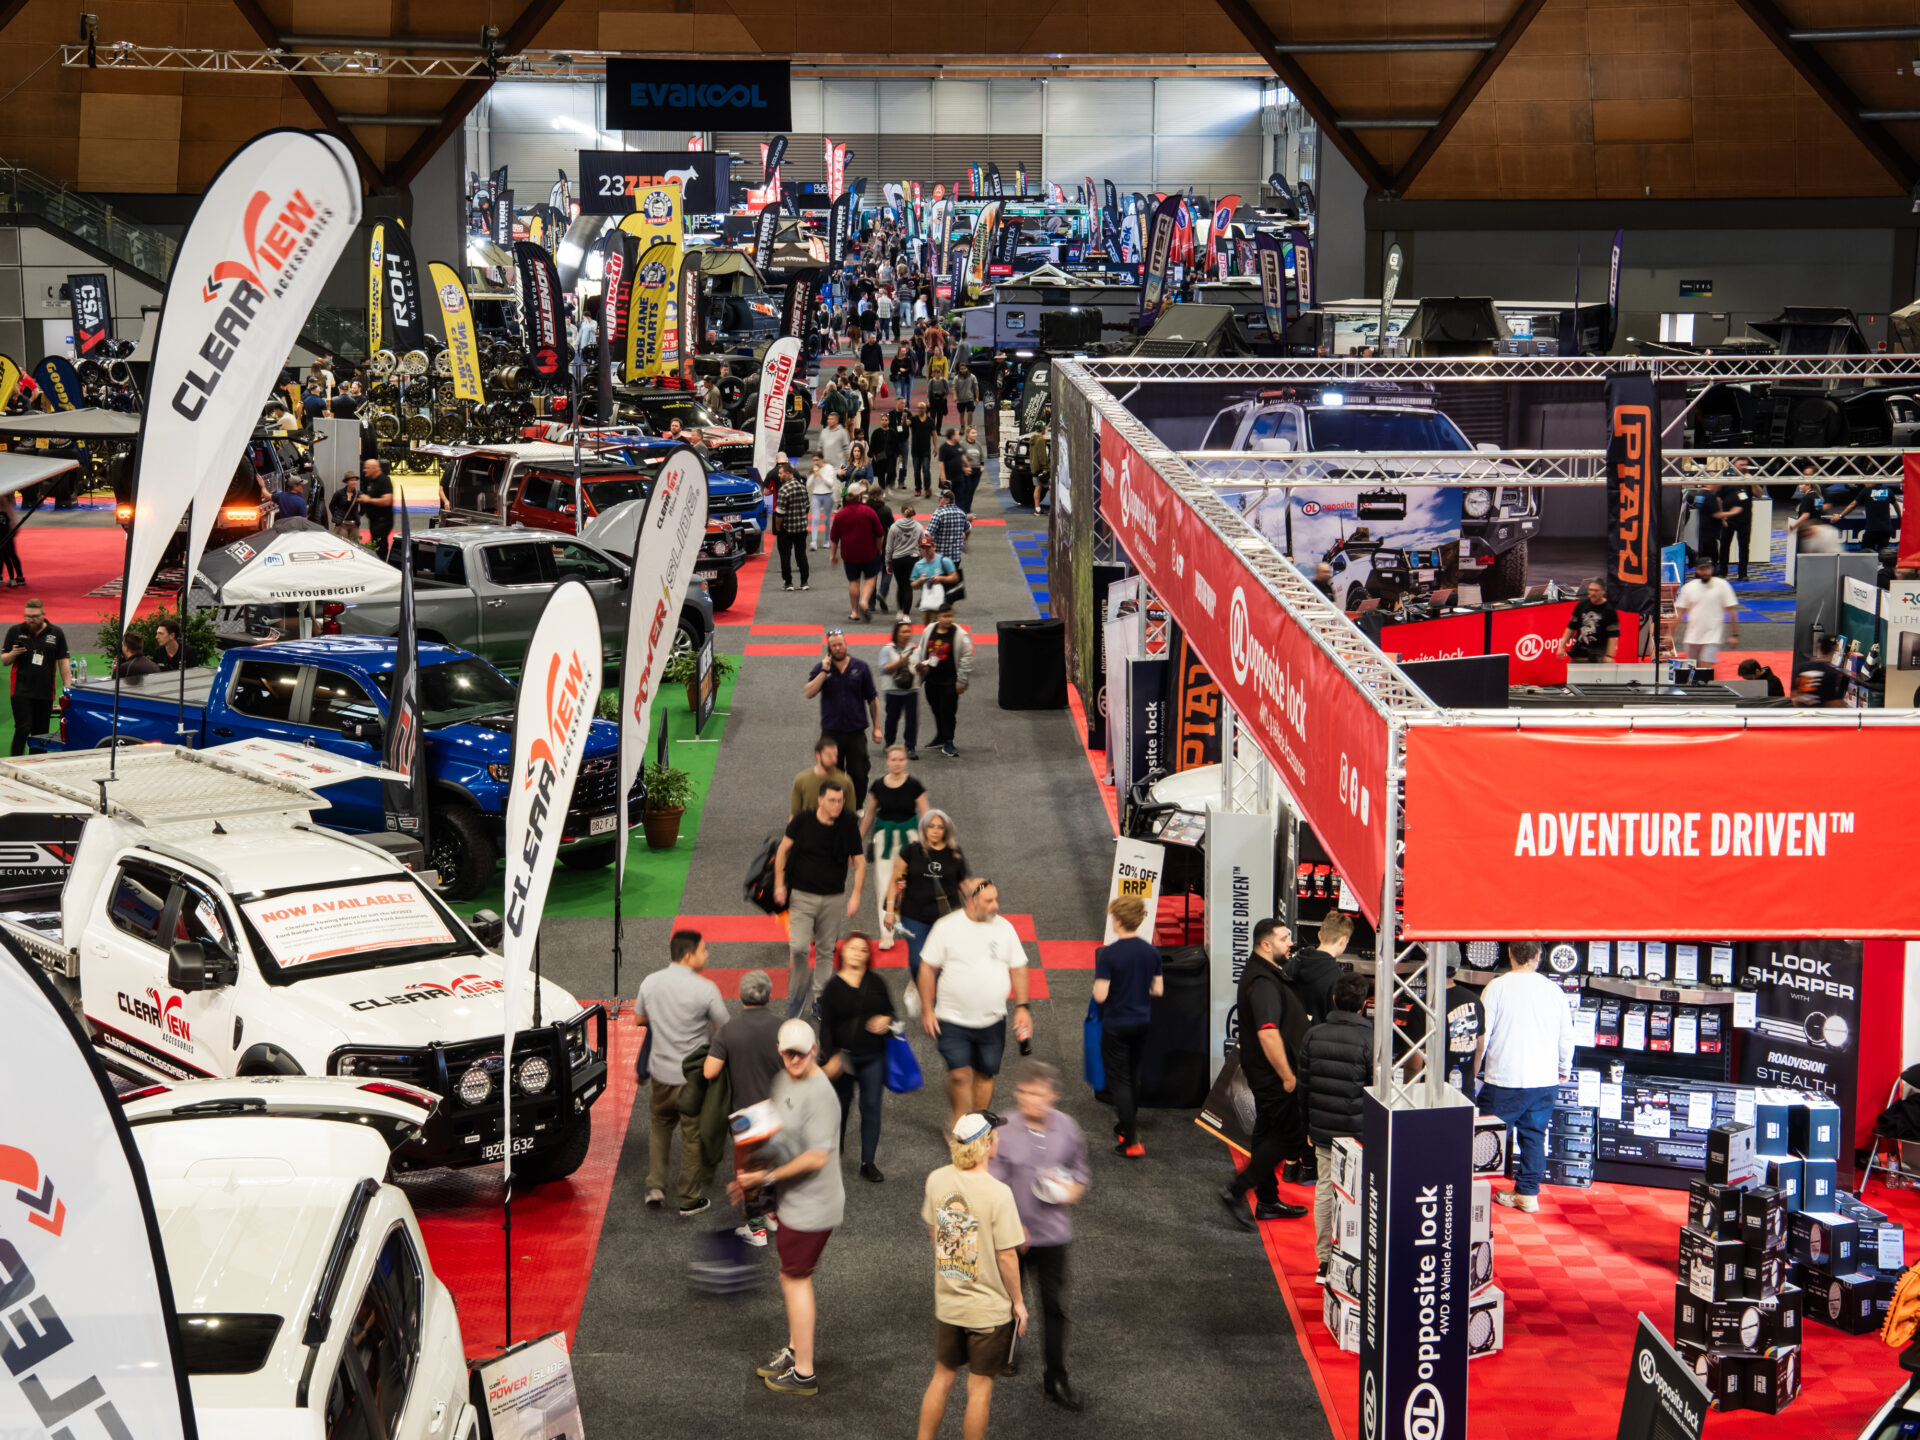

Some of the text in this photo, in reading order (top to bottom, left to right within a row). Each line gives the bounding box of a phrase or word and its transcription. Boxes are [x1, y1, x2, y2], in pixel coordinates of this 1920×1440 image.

[273, 206, 334, 299] ACCESSORIES
[755, 213, 771, 269] METHOD
[81, 284, 100, 329] CSA
[172, 189, 319, 422] CLEARVIEW
[386, 253, 409, 328] ROH
[403, 260, 417, 321] WHEELS
[534, 260, 554, 346] MONSTER
[791, 282, 806, 338] ONSTER
[636, 297, 650, 369] BOB JANE
[766, 354, 793, 431] NORWELD
[1322, 501, 1354, 512] opposite
[270, 586, 366, 598] #LIVEYOURBIGLIFE
[634, 598, 667, 724] POWER
[1233, 603, 1307, 743] OL opposite lock
[1146, 701, 1158, 734] lock
[506, 649, 584, 938] CLEARVIEW
[1514, 812, 1700, 857] ADVENTURE
[1118, 863, 1158, 883] 20% OFF
[1123, 880, 1147, 896] RRP
[261, 894, 416, 923] NOW AVAILABLE!
[1748, 966, 1855, 1000] SHARPER
[1771, 952, 1832, 978] LOOK
[118, 990, 191, 1042] CLEARVIEW
[1790, 993, 1810, 1002] WITH
[162, 1033, 194, 1055] ACCESSORIES
[1768, 1052, 1827, 1074] ROADVISION
[1756, 1067, 1836, 1095] STEALTH
[514, 1138, 534, 1152] 632
[1415, 1184, 1438, 1246] lock
[1440, 1184, 1454, 1336] 4WD & Vehicle Accessories
[1367, 1252, 1382, 1349] ADVENTURE
[1414, 1256, 1440, 1380] opposite
[490, 1376, 528, 1403] POWER
[1364, 1393, 1376, 1432] OL
[1642, 1355, 1699, 1432] OL opposite lock
